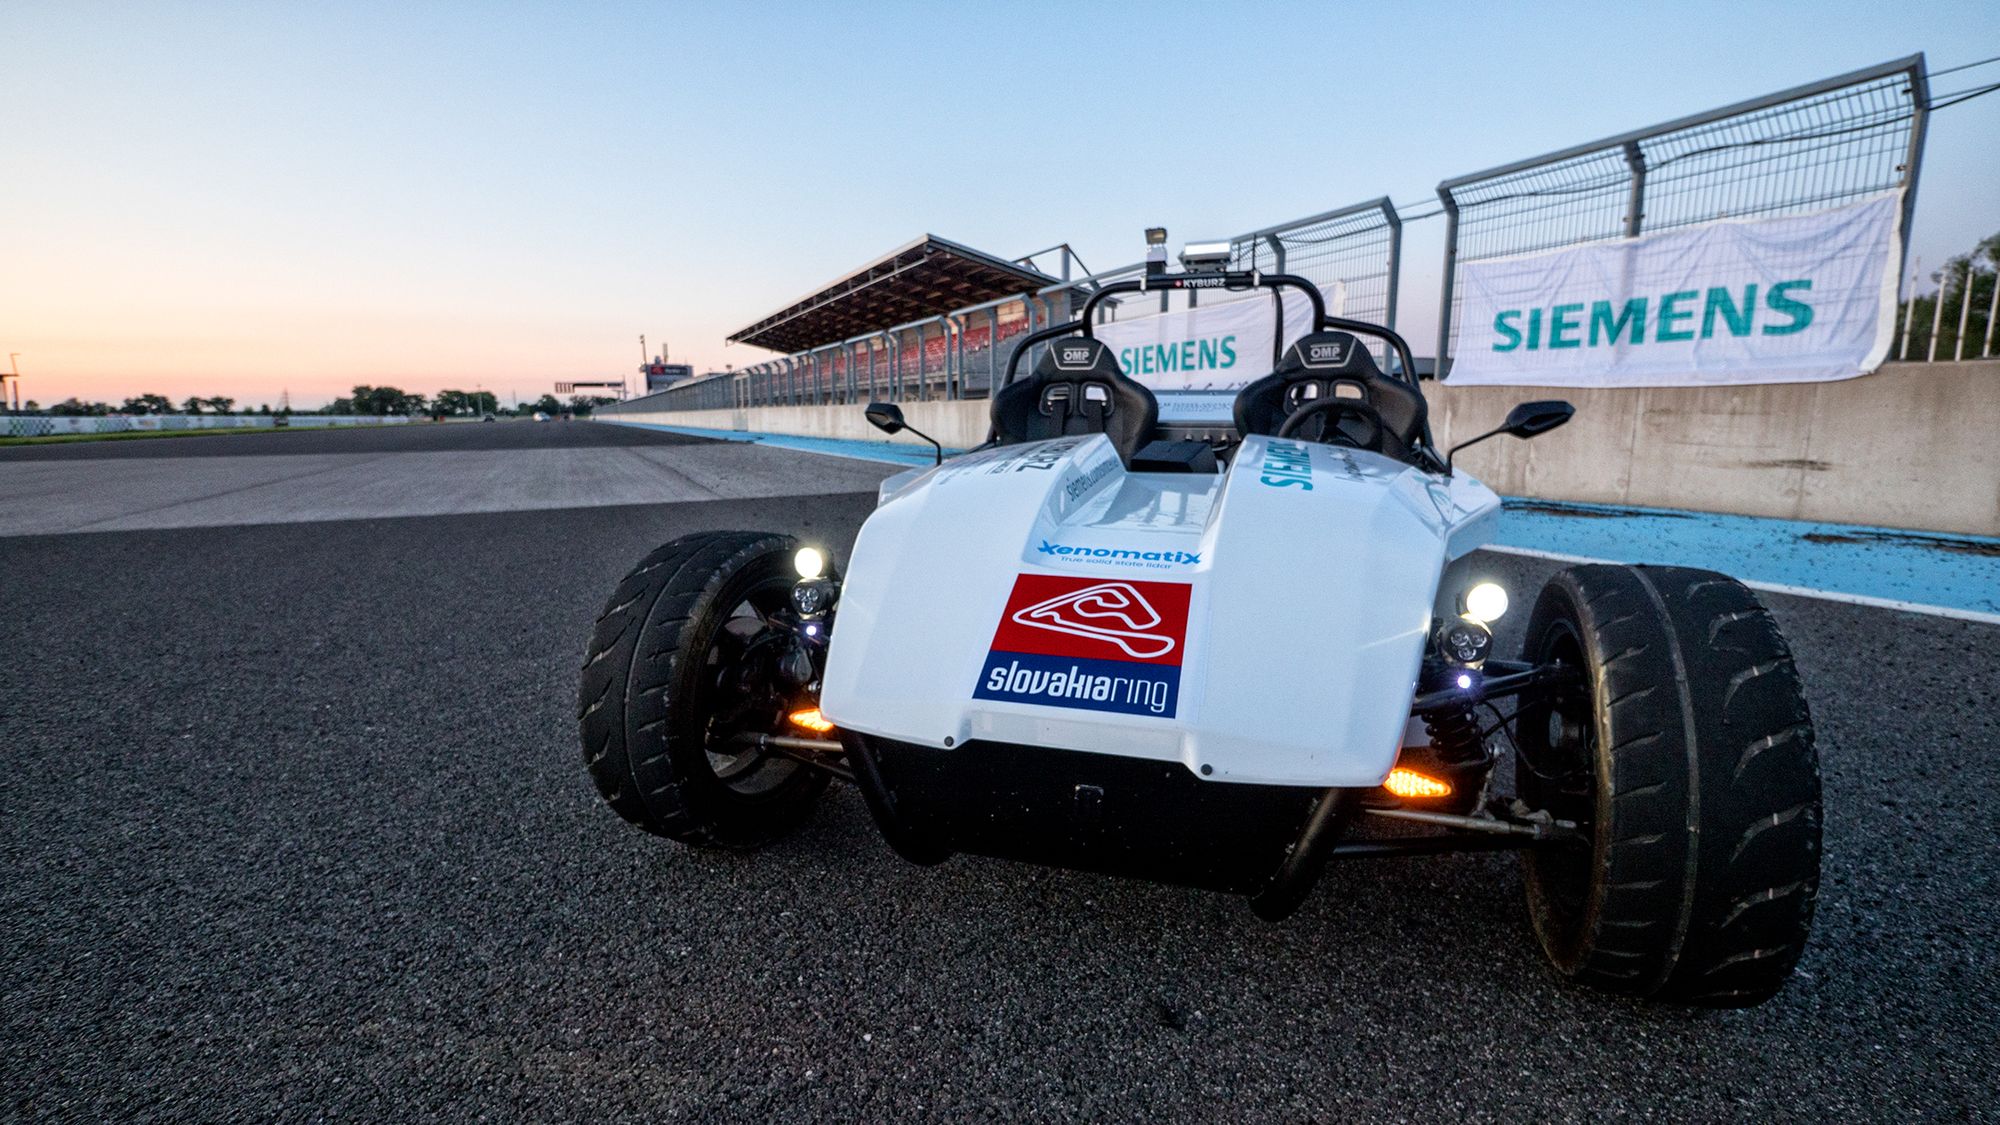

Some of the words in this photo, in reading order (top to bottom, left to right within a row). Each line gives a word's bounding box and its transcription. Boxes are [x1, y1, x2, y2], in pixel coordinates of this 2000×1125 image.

[1183, 278, 1226, 288] KYBURZ
[1492, 279, 1815, 353] SIEMENS
[1063, 350, 1090, 361] OMP
[1120, 336, 1237, 376] SIEMENS
[1310, 346, 1340, 358] OMP
[987, 661, 1168, 712] slovakiaring
